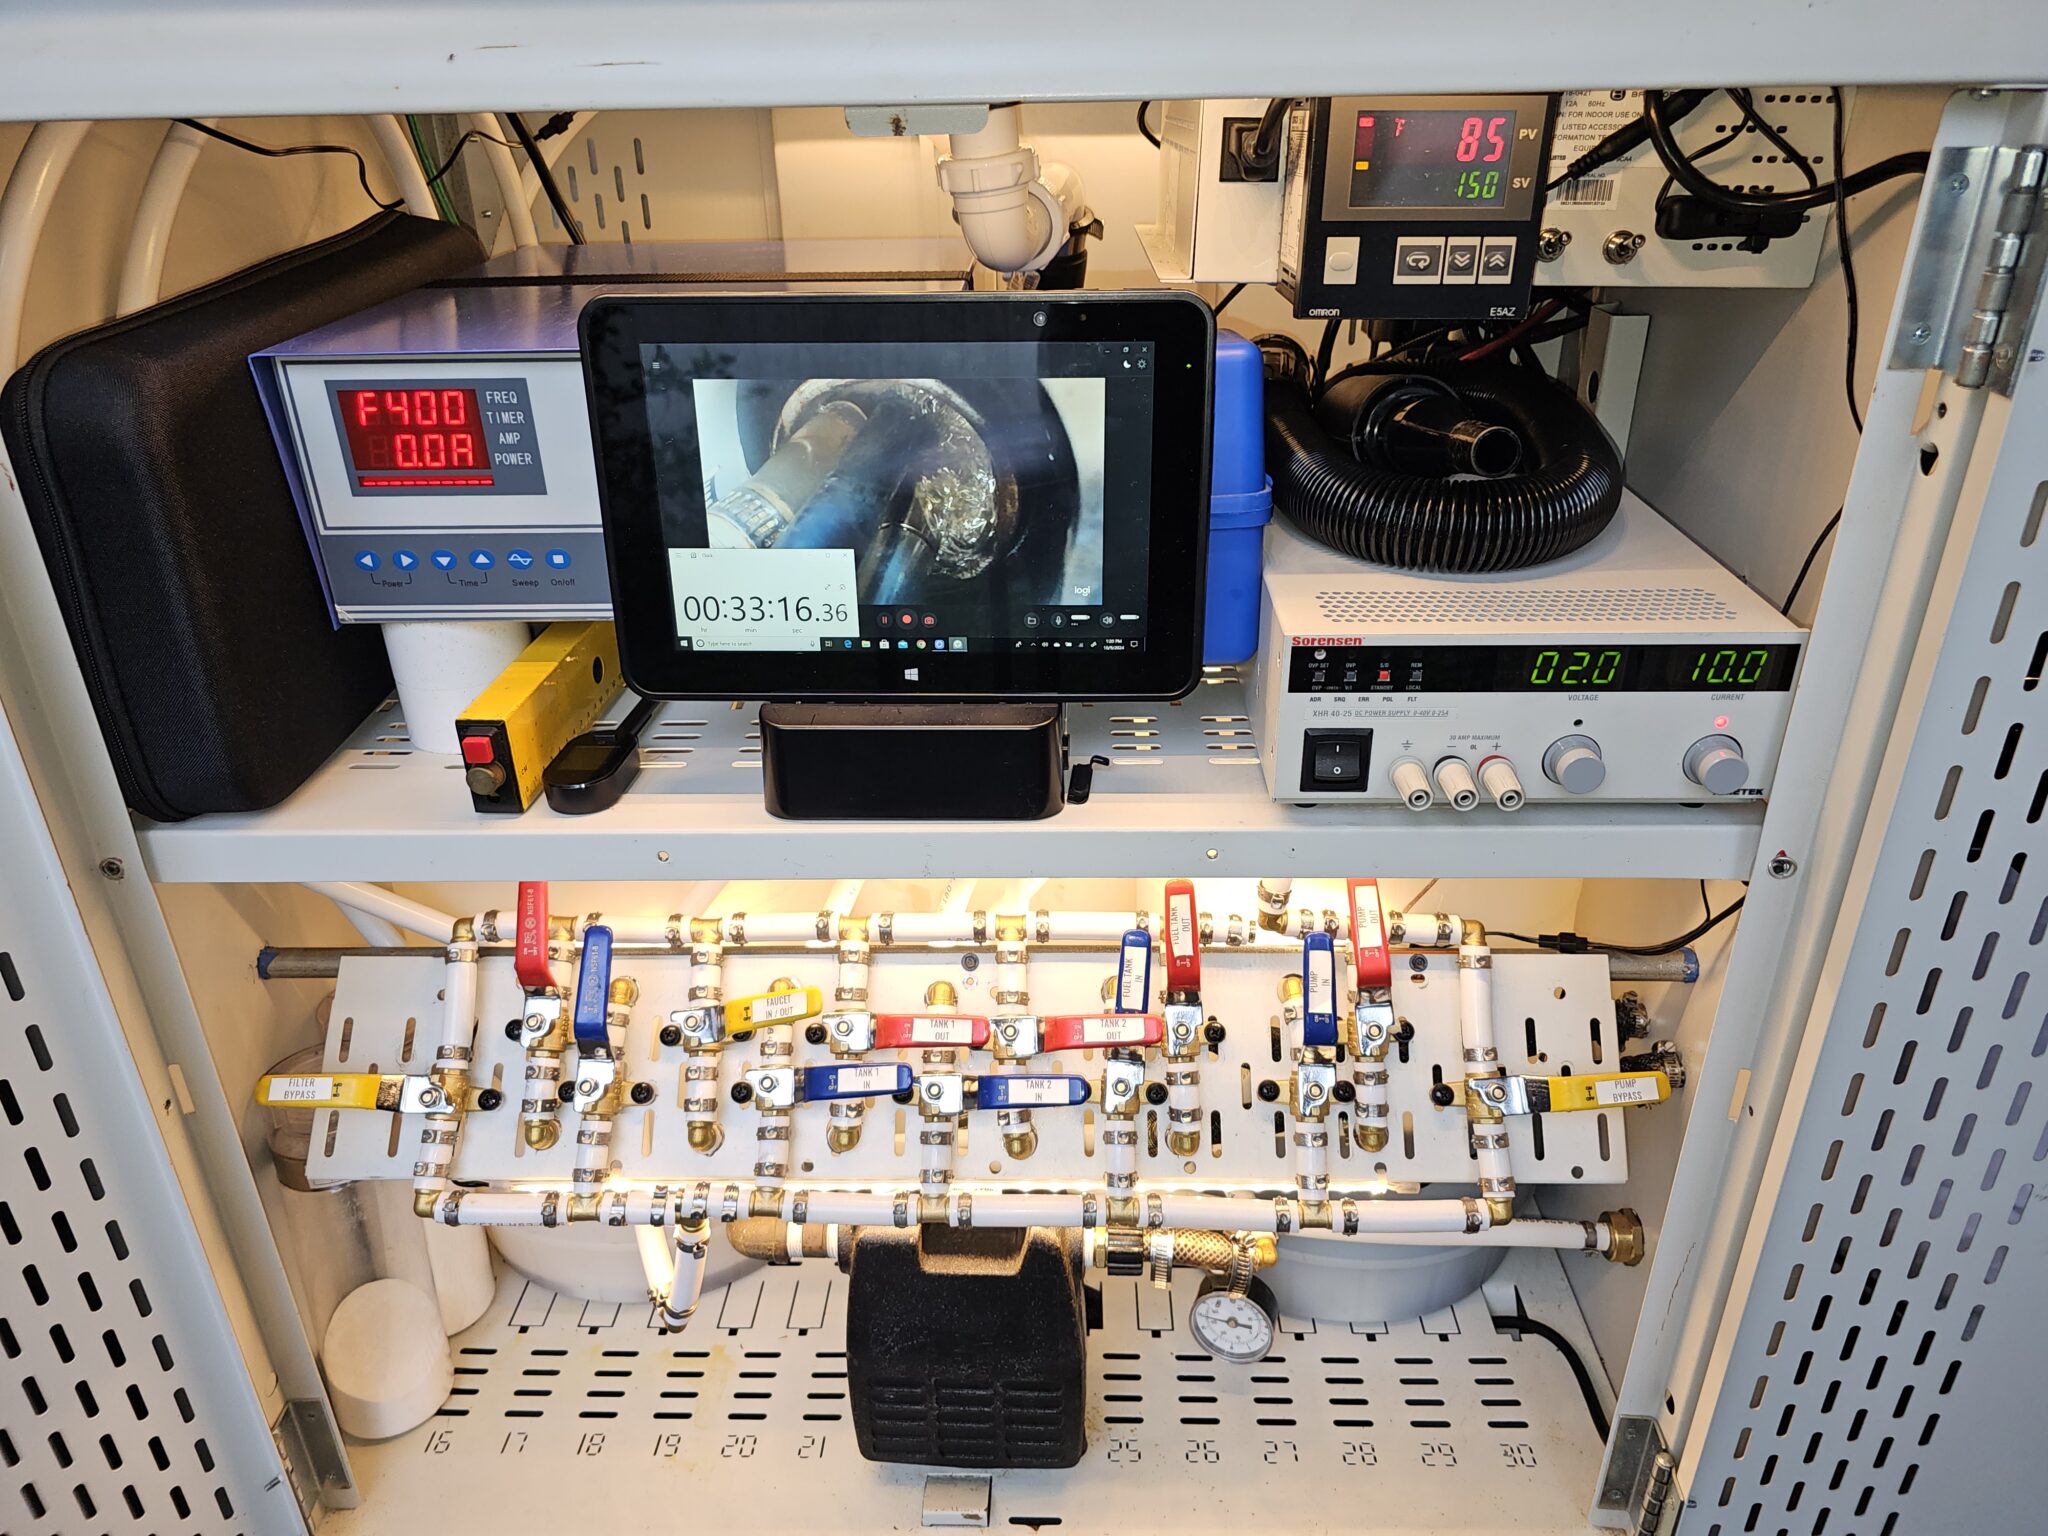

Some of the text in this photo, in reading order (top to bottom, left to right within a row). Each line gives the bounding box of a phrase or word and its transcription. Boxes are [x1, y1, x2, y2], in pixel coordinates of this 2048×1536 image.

[1456, 116, 1507, 162] 85
[1518, 128, 1538, 140] PV
[1457, 171, 1500, 199] 150
[1512, 177, 1531, 189] SV
[1490, 307, 1516, 317] E5AZ
[485, 391, 518, 405] FREQ
[357, 390, 466, 426] F400
[486, 411, 525, 424] TIMER
[499, 432, 521, 445] AMP
[495, 453, 533, 465] POWER
[382, 580, 403, 588] Power
[459, 579, 479, 587] Time
[512, 579, 539, 588] Sweep
[551, 578, 575, 586] On/off
[1075, 586, 1090, 596] logi
[1292, 636, 1363, 646] Sorensen
[1530, 651, 1622, 684] 02.0
[1691, 650, 1769, 683] 10.0
[1711, 693, 1745, 701] CURRENT
[1358, 907, 1367, 928] PUMP
[1371, 910, 1379, 924] OUT
[1170, 906, 1180, 945] FUEL TANK
[1182, 918, 1191, 932] OUT
[1122, 958, 1133, 998] FUEL TANK
[1135, 975, 1143, 983] IN
[1309, 971, 1318, 993] PUMP
[1322, 978, 1330, 987] IN
[766, 994, 791, 1007] FAUCET
[765, 1010, 773, 1019] IN
[779, 1006, 794, 1017] OUT
[929, 1018, 949, 1028] TANK
[1100, 1018, 1127, 1028] TANK 2
[934, 1030, 950, 1040] OUT
[1106, 1030, 1121, 1040] OUT
[854, 1067, 873, 1078] TANK
[288, 1078, 315, 1087] FILTER
[863, 1079, 871, 1089] IN
[1025, 1079, 1052, 1089] TANK 2
[1614, 1078, 1637, 1088] PUMP
[283, 1090, 316, 1100] BYPASS
[1035, 1092, 1042, 1101] IN
[1612, 1091, 1642, 1102] BYPASS
[424, 1430, 454, 1454] 16
[501, 1432, 528, 1454] 17
[577, 1432, 606, 1456] 18
[653, 1433, 682, 1457] 19
[720, 1434, 757, 1458] 20
[797, 1435, 826, 1459] 21
[1107, 1439, 1142, 1463] 25
[1185, 1439, 1220, 1464] 26
[1263, 1440, 1299, 1464] 27
[1342, 1441, 1378, 1466] 28
[1421, 1442, 1457, 1467] 29
[1499, 1443, 1538, 1468] 30
